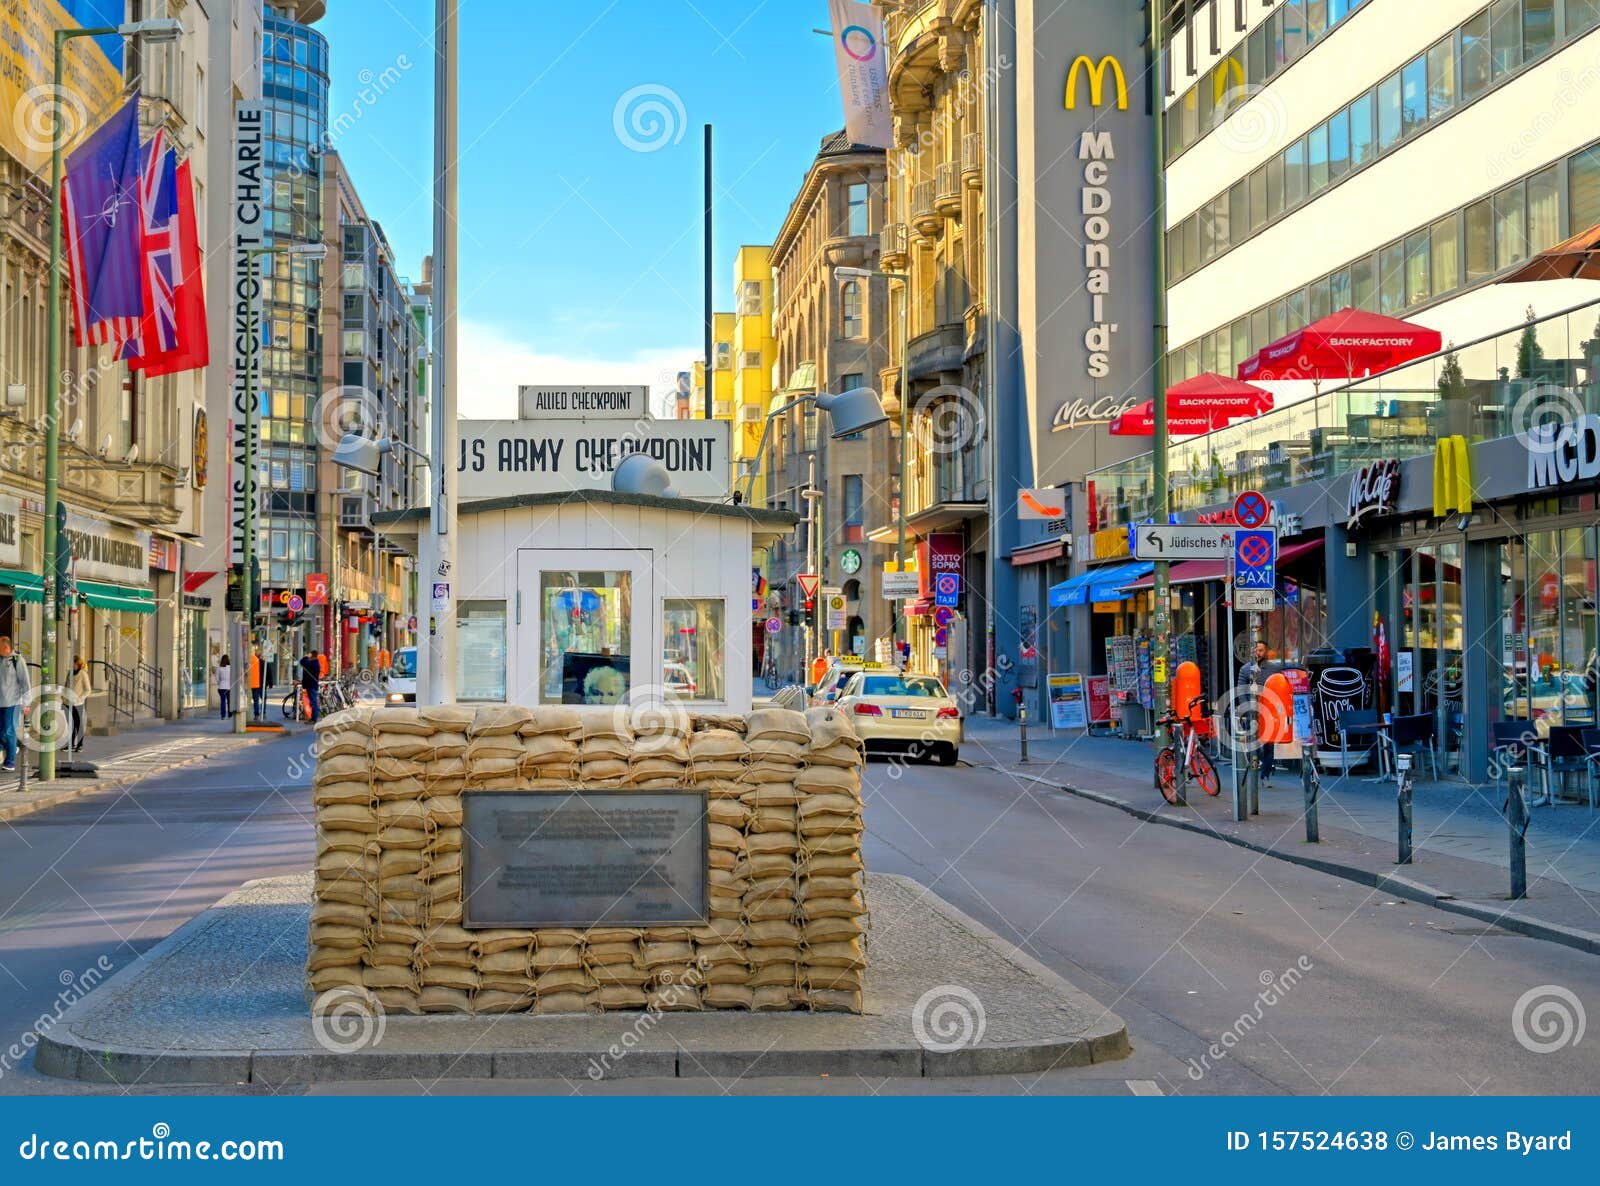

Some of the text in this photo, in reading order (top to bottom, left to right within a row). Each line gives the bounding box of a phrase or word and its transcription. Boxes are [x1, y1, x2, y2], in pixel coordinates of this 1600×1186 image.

[238, 110, 261, 225] CHARLIE
[1079, 131, 1118, 378] McDonald's
[535, 391, 632, 410] ALLIED CHECKPOINT
[1053, 396, 1136, 429] McCaf
[498, 438, 564, 472] ARMY
[1169, 536, 1217, 548] Jüdisches
[931, 554, 961, 562] SOTTO
[931, 561, 961, 569] SOPRA
[1239, 571, 1271, 584] TAXI
[937, 595, 956, 604] TAXI
